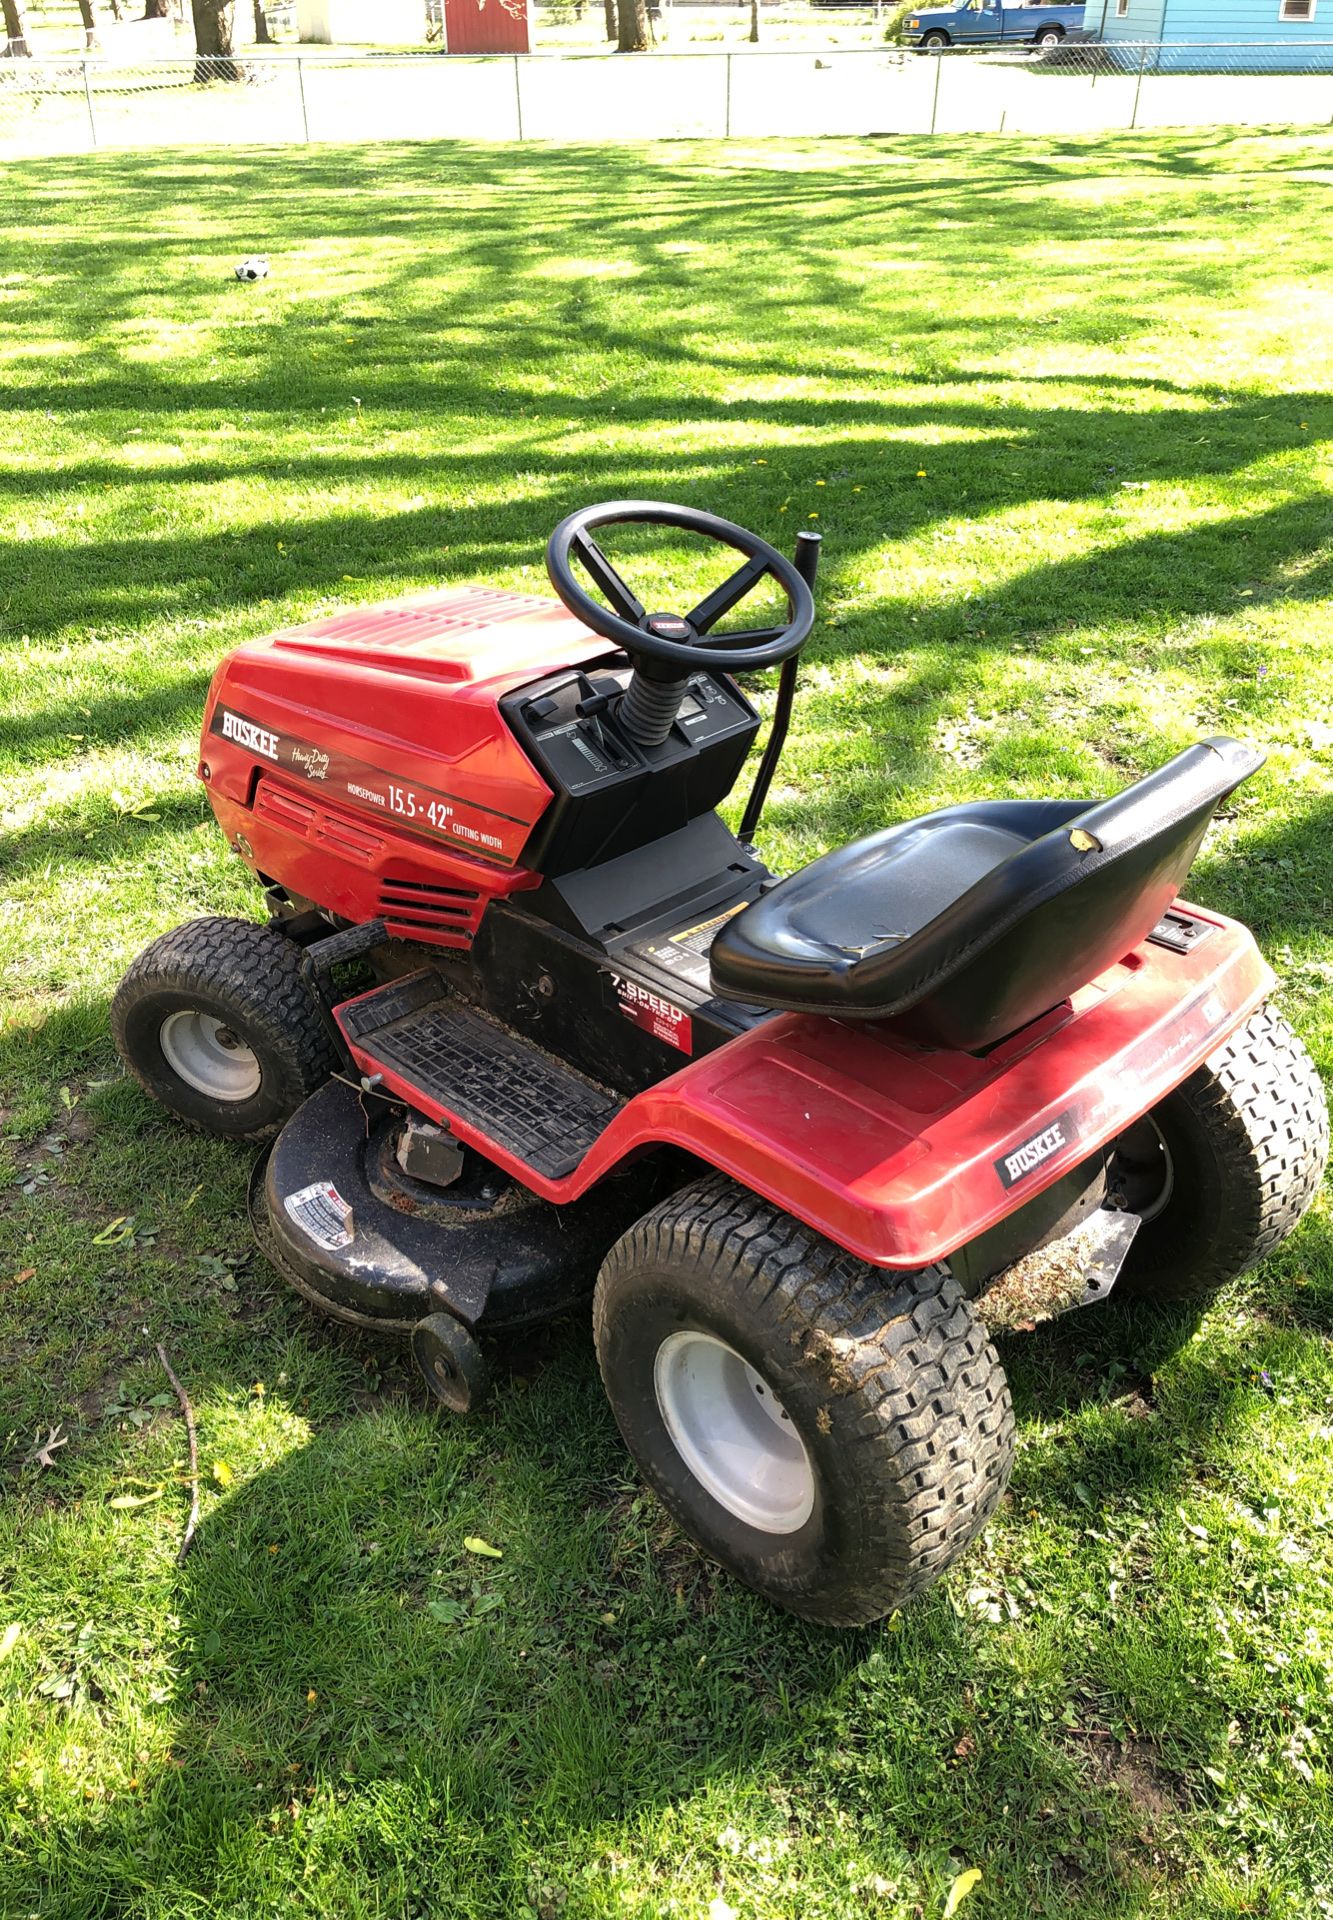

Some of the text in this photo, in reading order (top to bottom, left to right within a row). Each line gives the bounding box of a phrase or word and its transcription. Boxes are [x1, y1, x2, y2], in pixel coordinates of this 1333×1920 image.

[222, 711, 280, 760] HUSKEE
[307, 764, 329, 779] Series
[347, 782, 386, 807] HORSEPOWER
[388, 785, 416, 818] 15.5
[452, 823, 480, 842] CUTTING
[480, 832, 503, 850] WIDTH
[1004, 1122, 1066, 1181] HUSKEE
